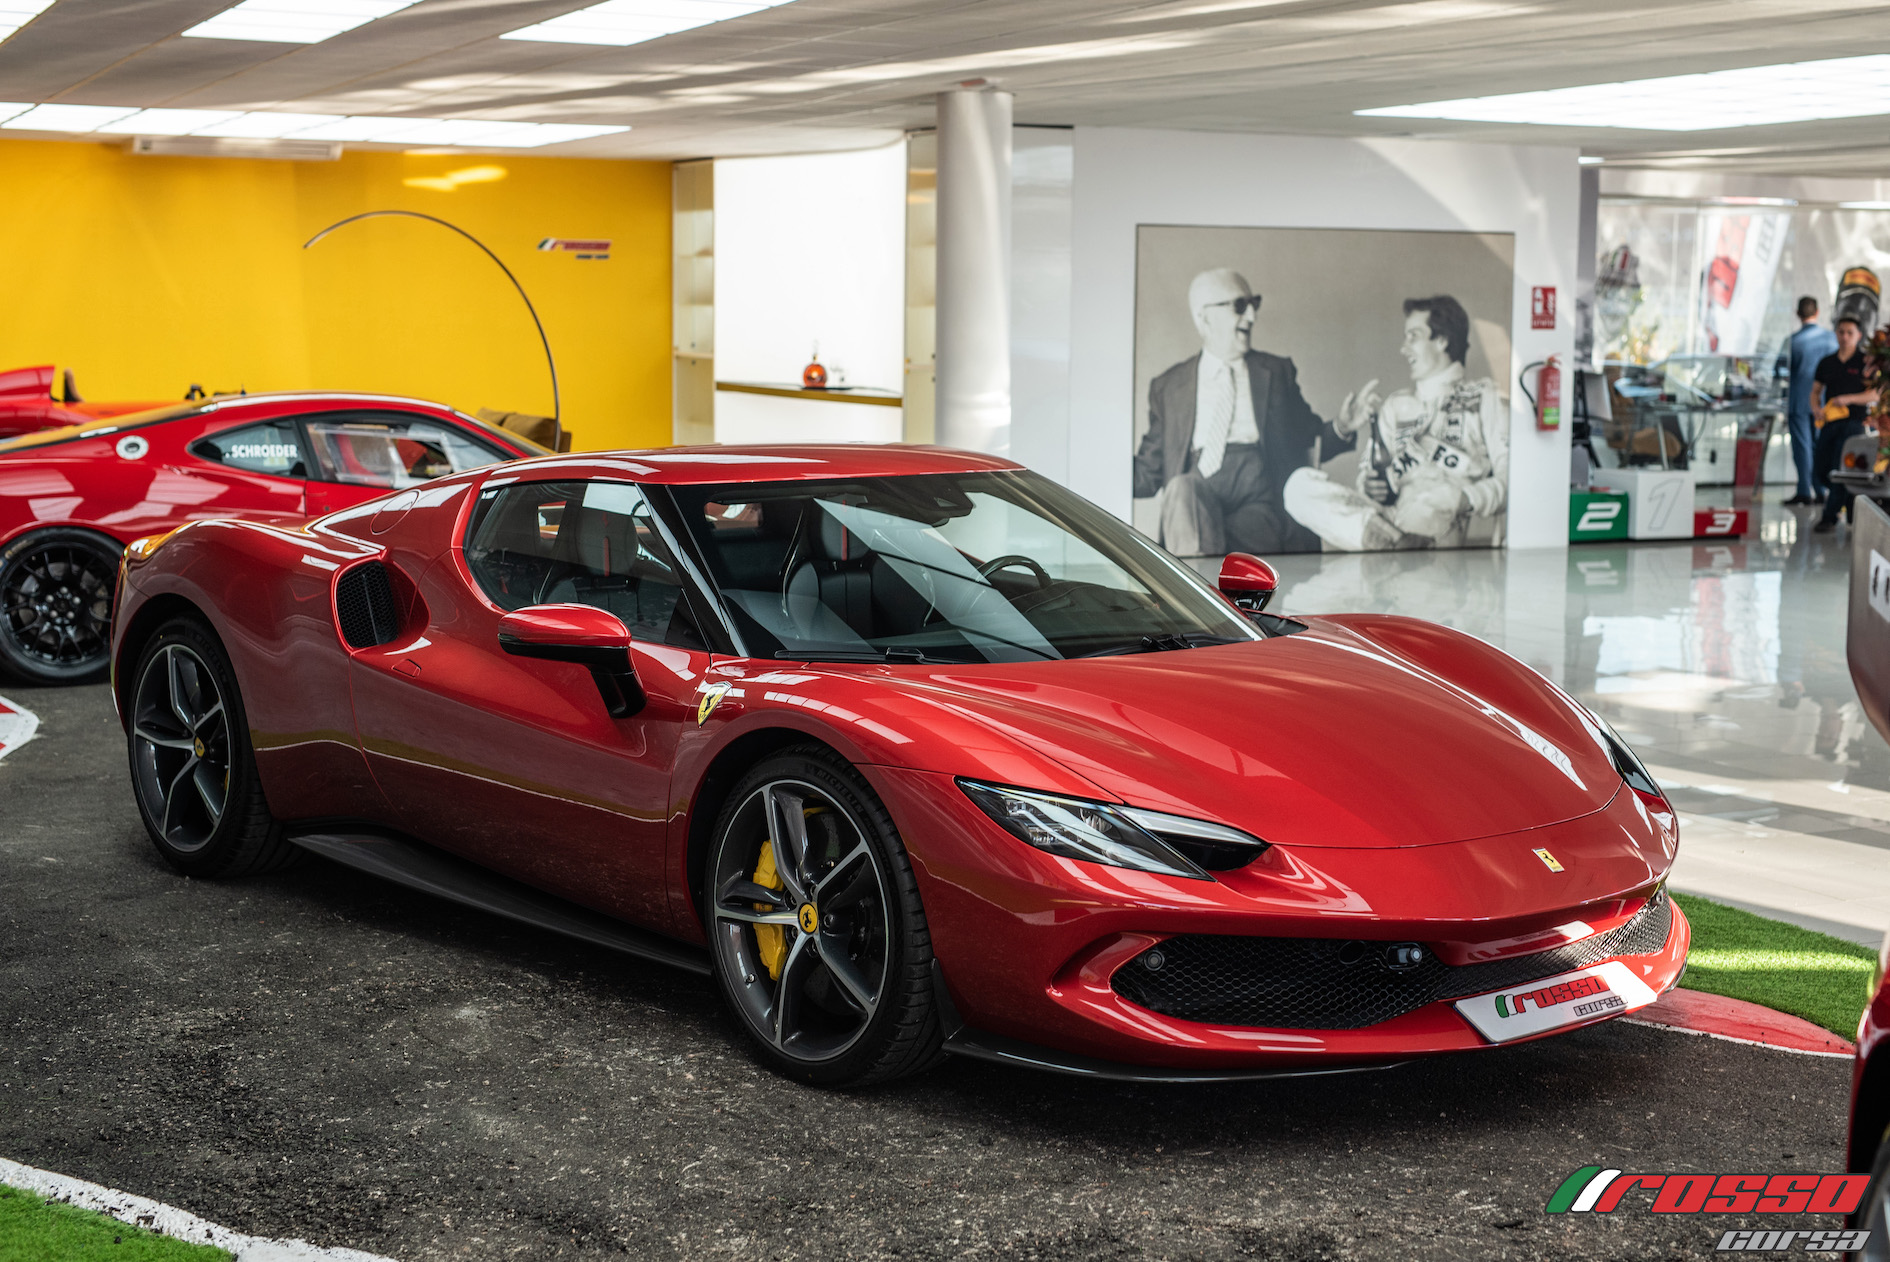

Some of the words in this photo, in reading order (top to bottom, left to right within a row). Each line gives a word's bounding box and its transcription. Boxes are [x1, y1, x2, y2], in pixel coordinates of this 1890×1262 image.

[231, 444, 298, 459] SCHROEDER
[1576, 501, 1622, 531] 2
[1647, 478, 1685, 532] 1
[1705, 513, 1737, 534] 3
[815, 769, 866, 815] MICHELIN
